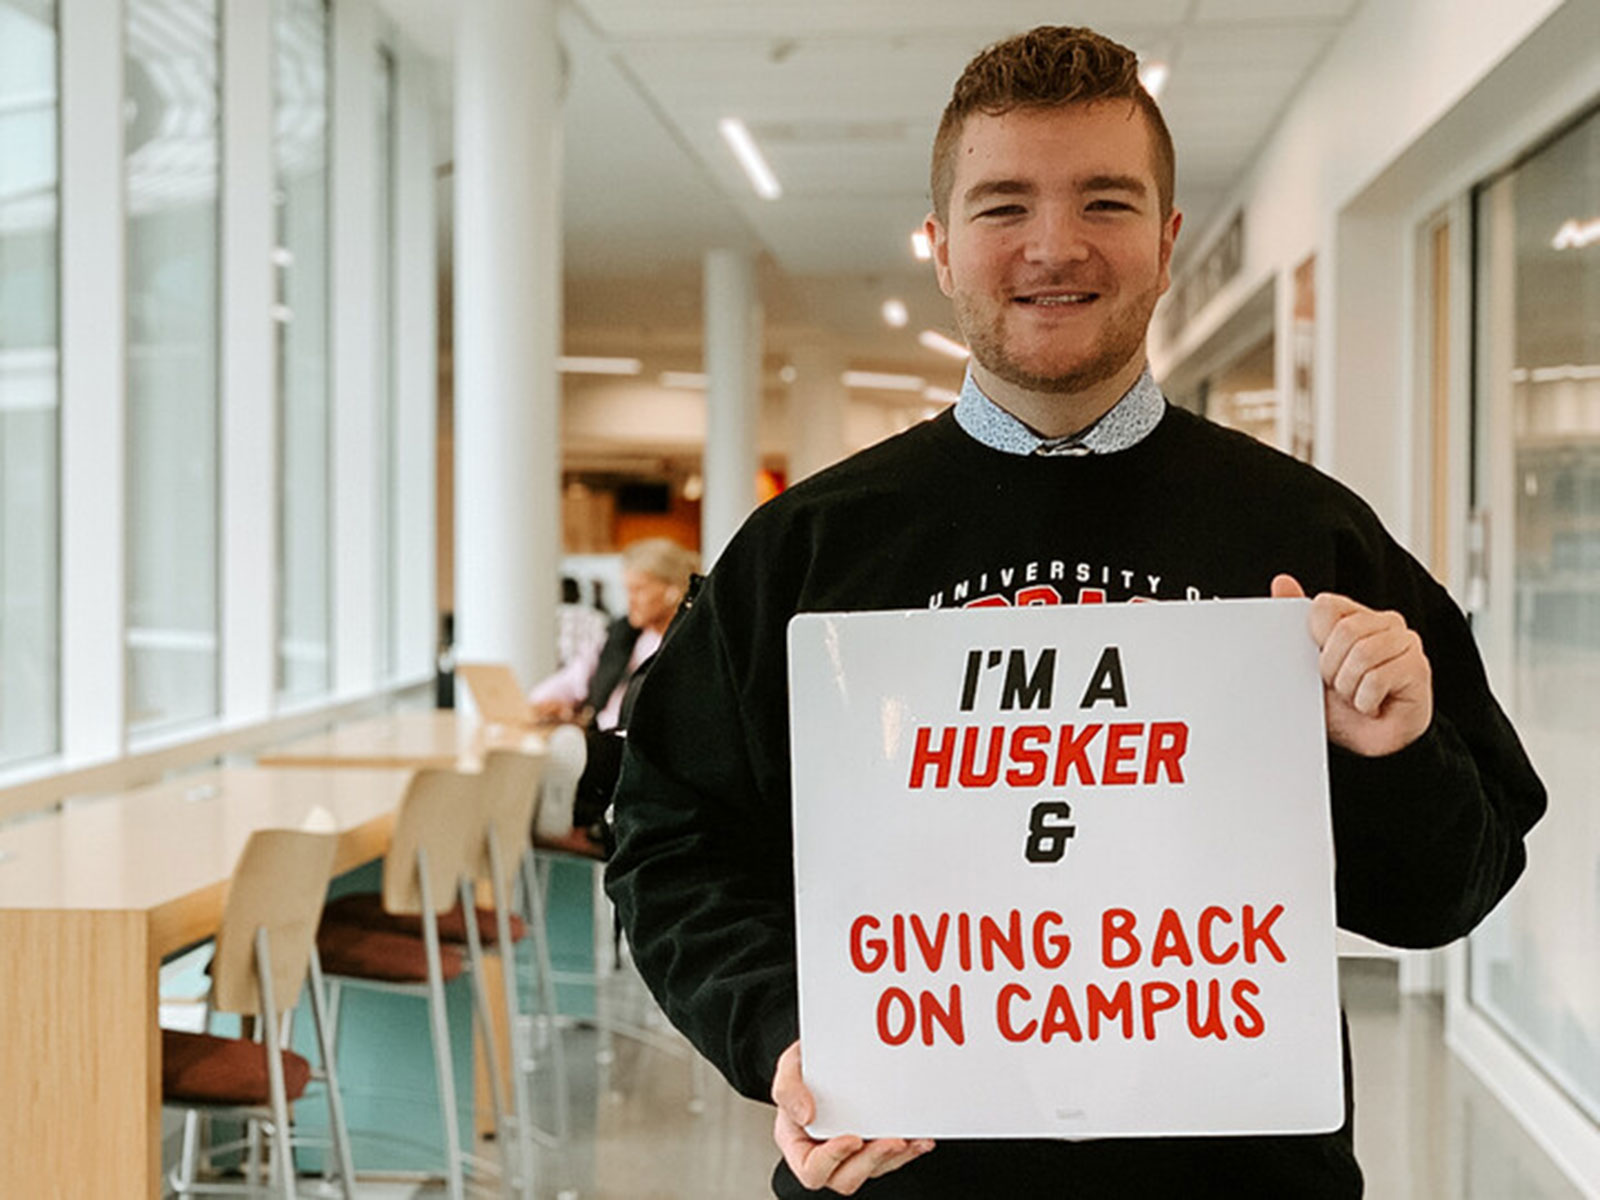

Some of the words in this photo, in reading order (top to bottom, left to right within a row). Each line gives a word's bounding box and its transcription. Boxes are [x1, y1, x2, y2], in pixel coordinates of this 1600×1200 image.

[928, 561, 1161, 610] UNIVERSITY
[960, 648, 1057, 711] I'M
[1080, 646, 1128, 708] A
[908, 721, 1189, 789] HUSKER
[1024, 801, 1076, 863] &
[849, 909, 1071, 974] GIVING
[1101, 904, 1287, 969] BACK
[876, 984, 965, 1046] ON
[996, 978, 1265, 1044] CAMPUS
